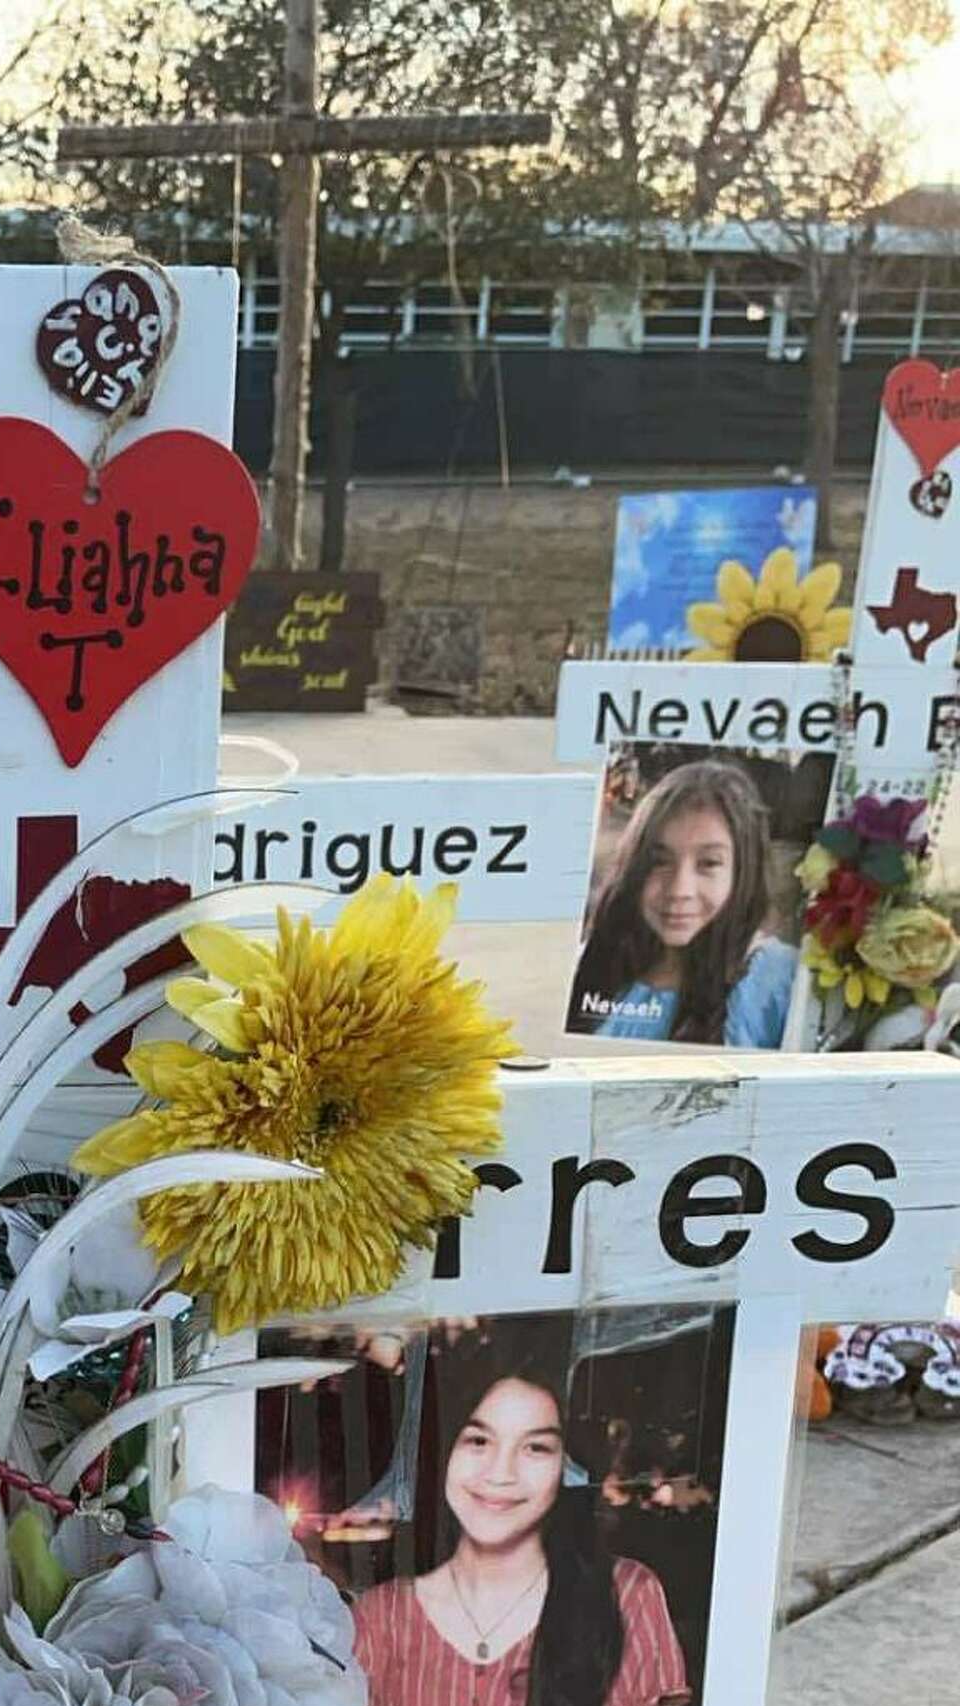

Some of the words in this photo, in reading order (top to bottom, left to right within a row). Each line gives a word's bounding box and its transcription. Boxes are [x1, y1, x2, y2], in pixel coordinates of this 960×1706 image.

[39, 630, 123, 712] T
[594, 689, 889, 748] Nevaeh
[581, 990, 663, 1017] Nevaeh
